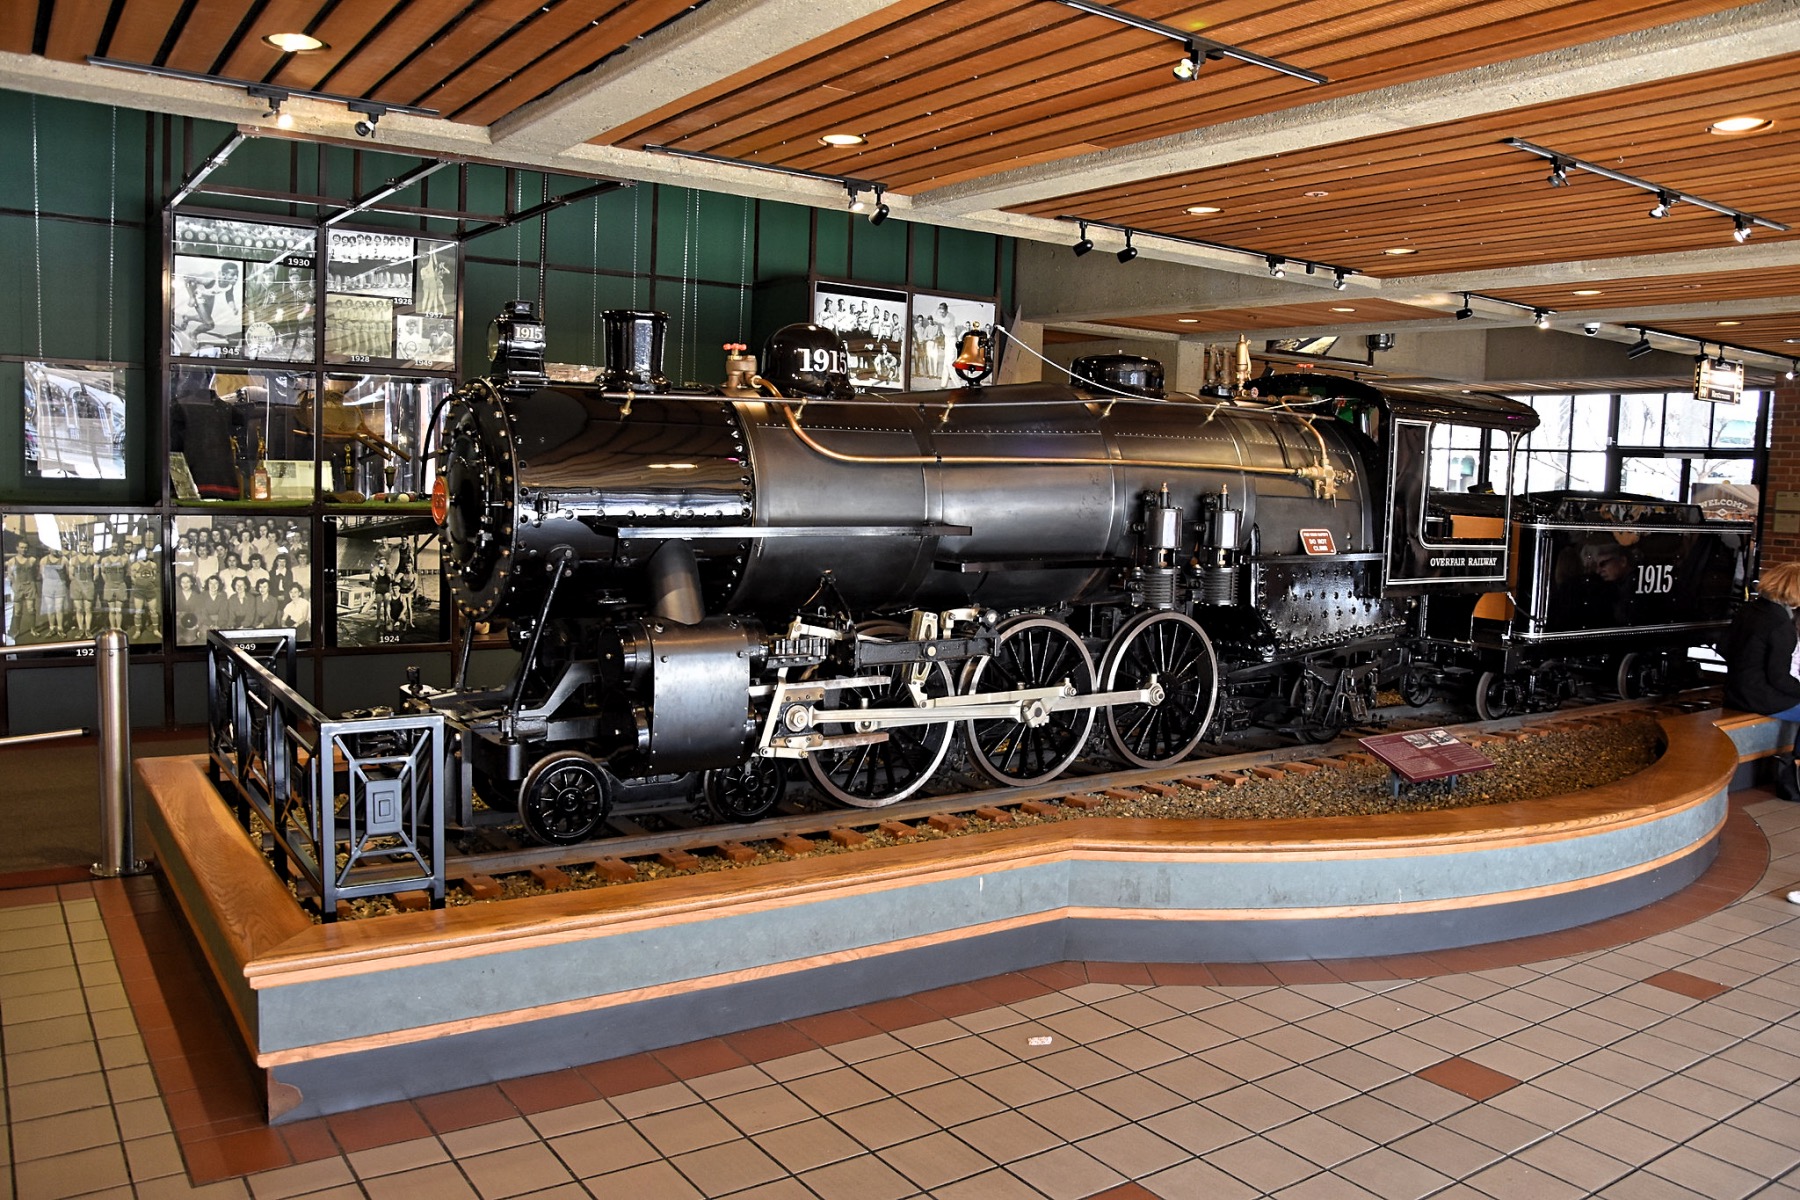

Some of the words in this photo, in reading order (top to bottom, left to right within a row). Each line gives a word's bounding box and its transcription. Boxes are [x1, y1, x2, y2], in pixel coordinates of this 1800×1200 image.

[288, 258, 310, 267] 1930
[393, 297, 413, 305] 1928
[515, 326, 543, 340] 1915
[351, 355, 370, 363] 1928
[797, 348, 847, 375] 1915
[1698, 498, 1748, 511] WELCOME
[1429, 557, 1466, 567] OVERFAIR
[1468, 557, 1498, 566] RAILWAY
[1635, 564, 1674, 594] 1915
[379, 635, 400, 643] 1924
[235, 643, 256, 651] 949
[76, 648, 95, 657] 192
